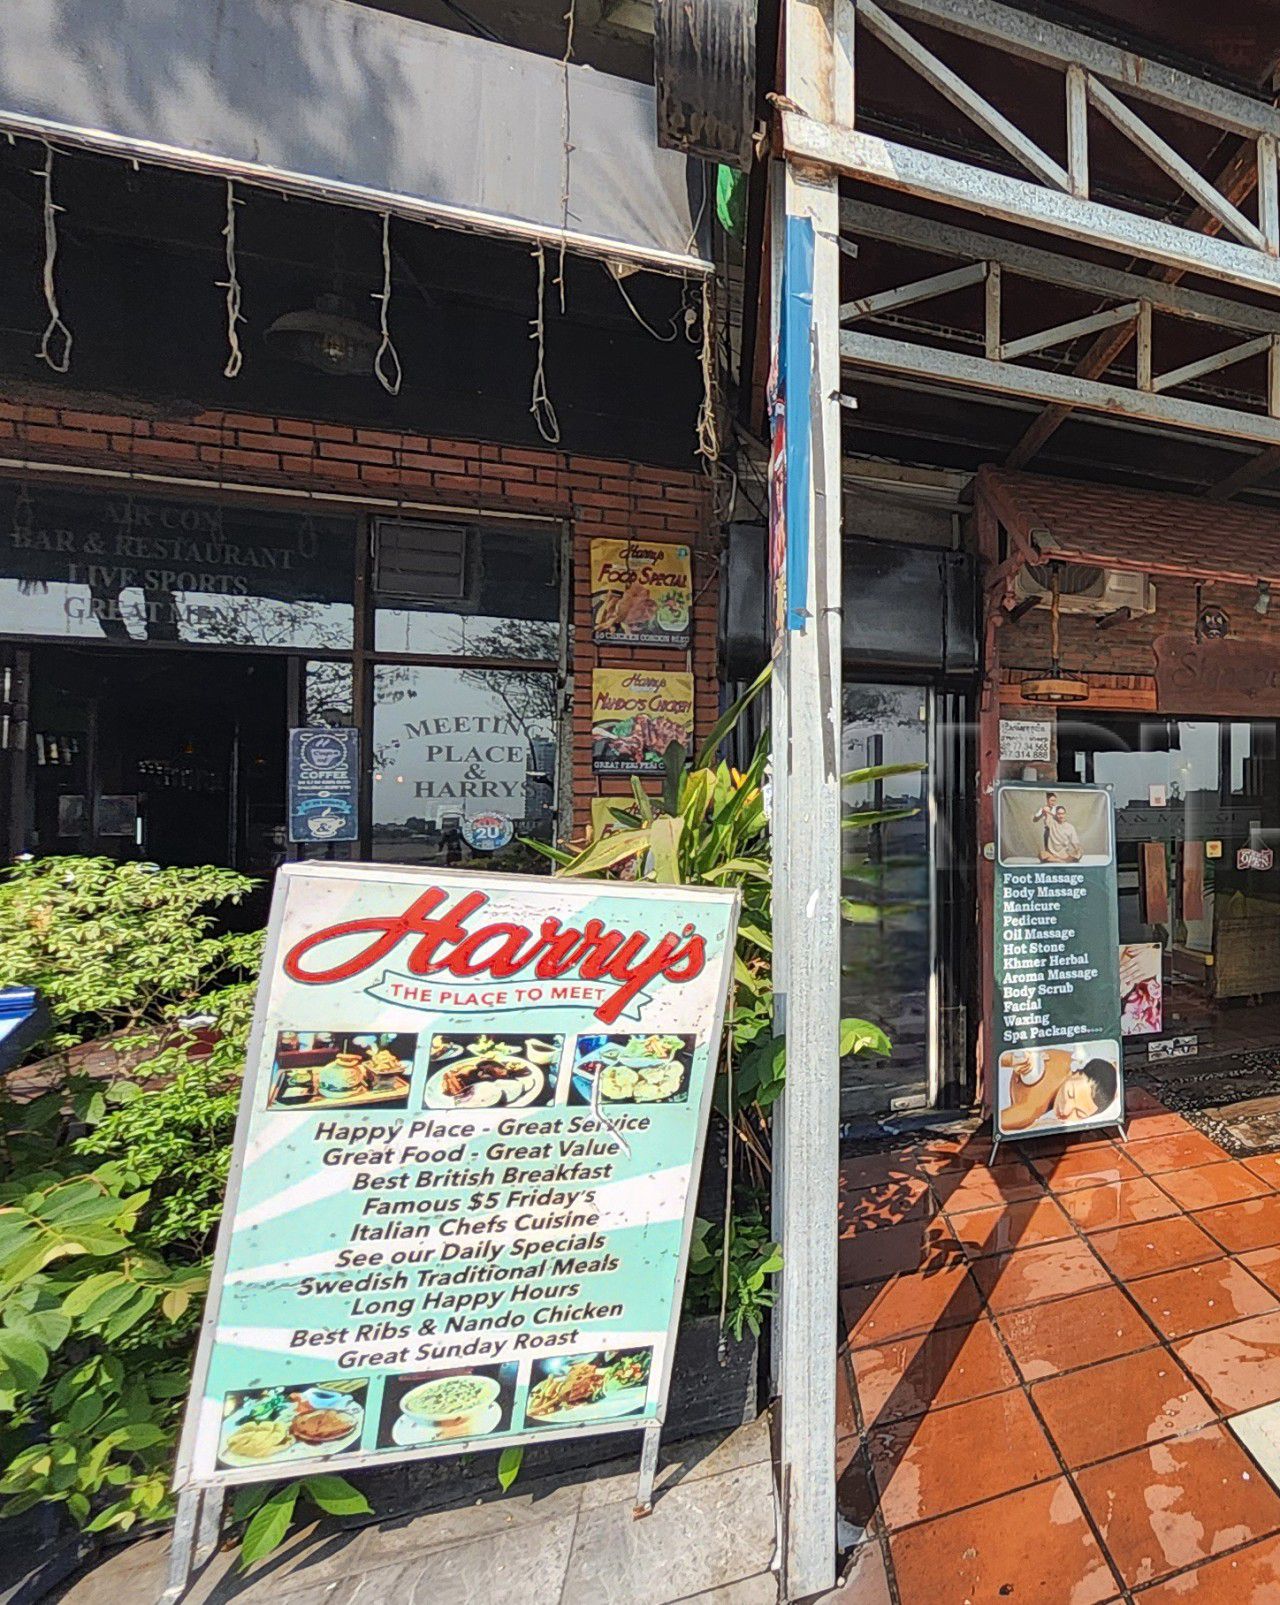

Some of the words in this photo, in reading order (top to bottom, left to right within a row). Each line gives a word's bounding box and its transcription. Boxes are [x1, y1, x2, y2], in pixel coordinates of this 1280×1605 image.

[11, 526, 75, 551] BAR
[84, 533, 105, 554] &
[116, 534, 293, 570] RESTAURANT
[68, 563, 138, 588] LIVE
[145, 568, 248, 595] SPORTS
[65, 596, 168, 623] GREAT
[403, 714, 543, 740] MEETING
[426, 745, 524, 763] PLACE
[301, 771, 348, 779] COFFEE
[464, 763, 487, 780] &
[414, 781, 536, 799] HARRYS
[1003, 873, 1033, 884] Foot
[1034, 873, 1084, 885] Massage
[1003, 887, 1035, 900] Body
[1037, 887, 1087, 899] Massage
[1003, 901, 1061, 912] Manicure
[1003, 915, 1057, 926] Pedicure
[1003, 929, 1022, 940] Oil
[1025, 929, 1075, 940] Massage
[283, 886, 708, 1025] Harry's
[1003, 944, 1027, 955] Hot
[1029, 943, 1065, 953] Stone
[1003, 957, 1047, 970] Khmer
[1049, 953, 1089, 966] Herbal
[1003, 972, 1044, 984] Aroma
[1047, 969, 1098, 981] Massage
[391, 983, 431, 1002] THE
[440, 990, 507, 1006] PLACE
[515, 987, 542, 1002] TO
[550, 986, 605, 1001] MEET
[1003, 985, 1036, 999] Body
[1038, 982, 1074, 995] Scrub
[1003, 998, 1042, 1012] Facial
[1003, 1013, 1050, 1027] Waxing
[1003, 1030, 1028, 1044] Spa
[314, 1121, 402, 1146] Happy
[409, 1120, 475, 1139] Place
[498, 1117, 562, 1136] Great
[568, 1115, 651, 1134] Service
[322, 1147, 395, 1166] Great
[400, 1144, 466, 1164] Food
[485, 1142, 553, 1161] Great
[559, 1140, 620, 1158] Value
[352, 1171, 410, 1191] Best
[415, 1167, 494, 1188] British
[501, 1163, 613, 1185] Breakfast
[362, 1196, 460, 1216] Famous
[466, 1191, 499, 1212] $5
[505, 1187, 596, 1210] Friday's
[350, 1219, 430, 1242] Italian
[438, 1216, 507, 1238] Chefs
[514, 1211, 600, 1231] Cuisine
[335, 1250, 383, 1268] See
[390, 1250, 433, 1265] our
[440, 1242, 504, 1263] Daily
[509, 1233, 606, 1258] Specials
[298, 1270, 408, 1296] Swedish
[416, 1259, 546, 1288] Traditional
[550, 1254, 620, 1276] Meals
[350, 1297, 415, 1318] Long
[421, 1289, 506, 1312] Happy
[510, 1282, 581, 1302] Hours
[289, 1328, 348, 1349] Best
[355, 1322, 410, 1343] Ribs
[417, 1318, 437, 1336] &
[445, 1311, 526, 1334] Nando
[532, 1302, 624, 1325] Chicken
[337, 1349, 412, 1370] Great
[415, 1337, 508, 1364] Sunday
[514, 1328, 579, 1351] Roast
